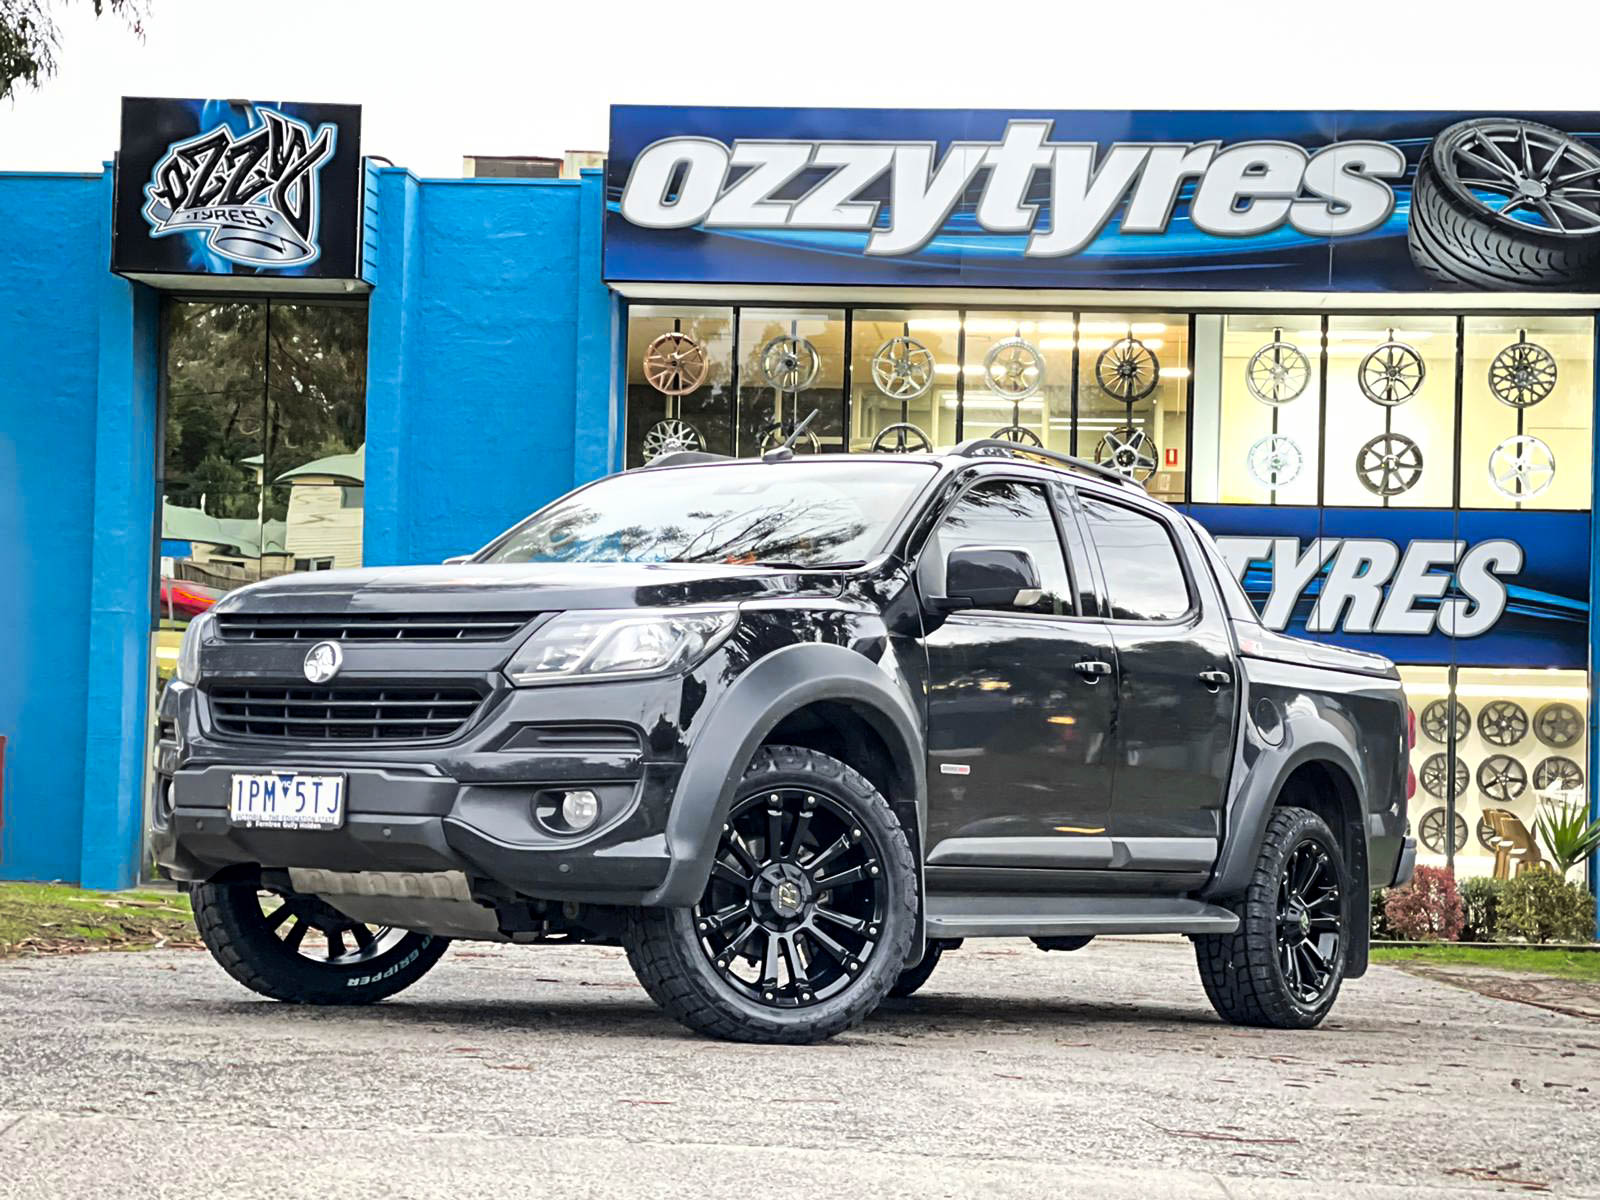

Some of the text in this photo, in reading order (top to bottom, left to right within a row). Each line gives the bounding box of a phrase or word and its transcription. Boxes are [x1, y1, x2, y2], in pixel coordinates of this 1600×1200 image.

[619, 118, 1406, 258] ozzytyres
[192, 209, 267, 229] TYRES
[238, 780, 340, 814] 1PM 5TJ
[347, 948, 420, 987] GRIPPER
